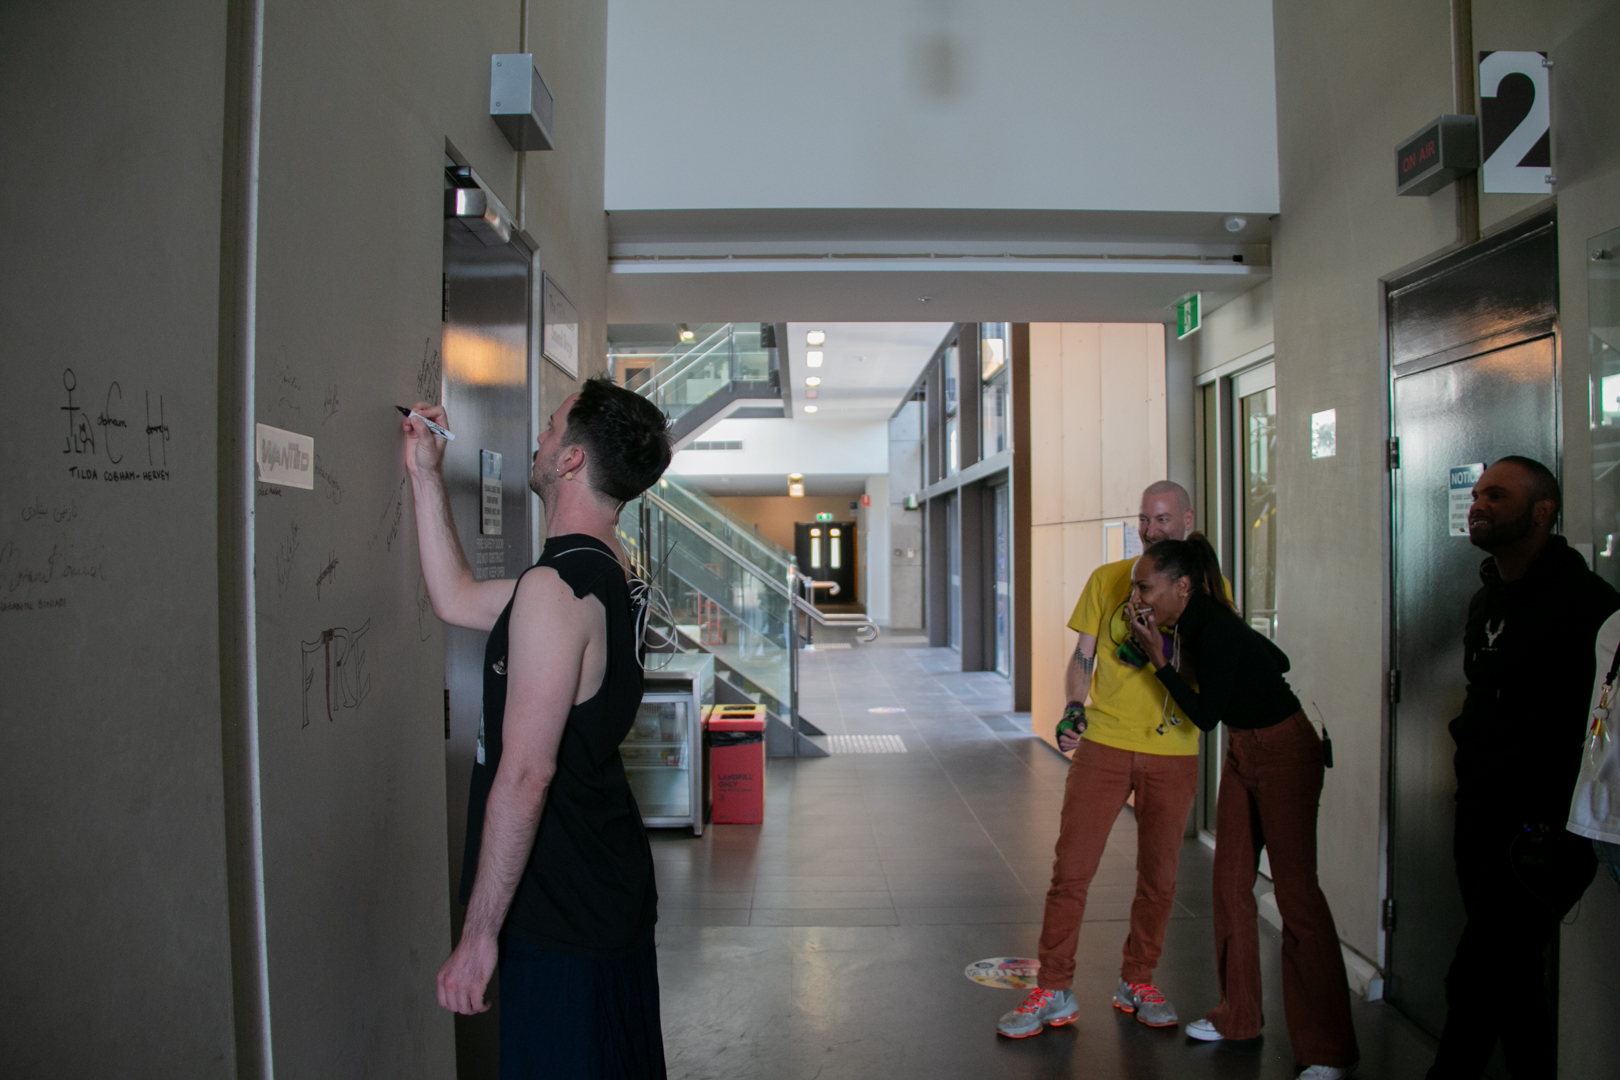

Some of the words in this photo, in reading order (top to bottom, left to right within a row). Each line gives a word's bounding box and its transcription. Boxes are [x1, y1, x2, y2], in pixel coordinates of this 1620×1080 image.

[1479, 51, 1552, 193] 2
[1402, 154, 1417, 173] ON
[1419, 140, 1436, 163] AIR
[261, 438, 311, 472] WANTED
[69, 466, 98, 480] TILDA
[302, 617, 371, 730] FIRE
